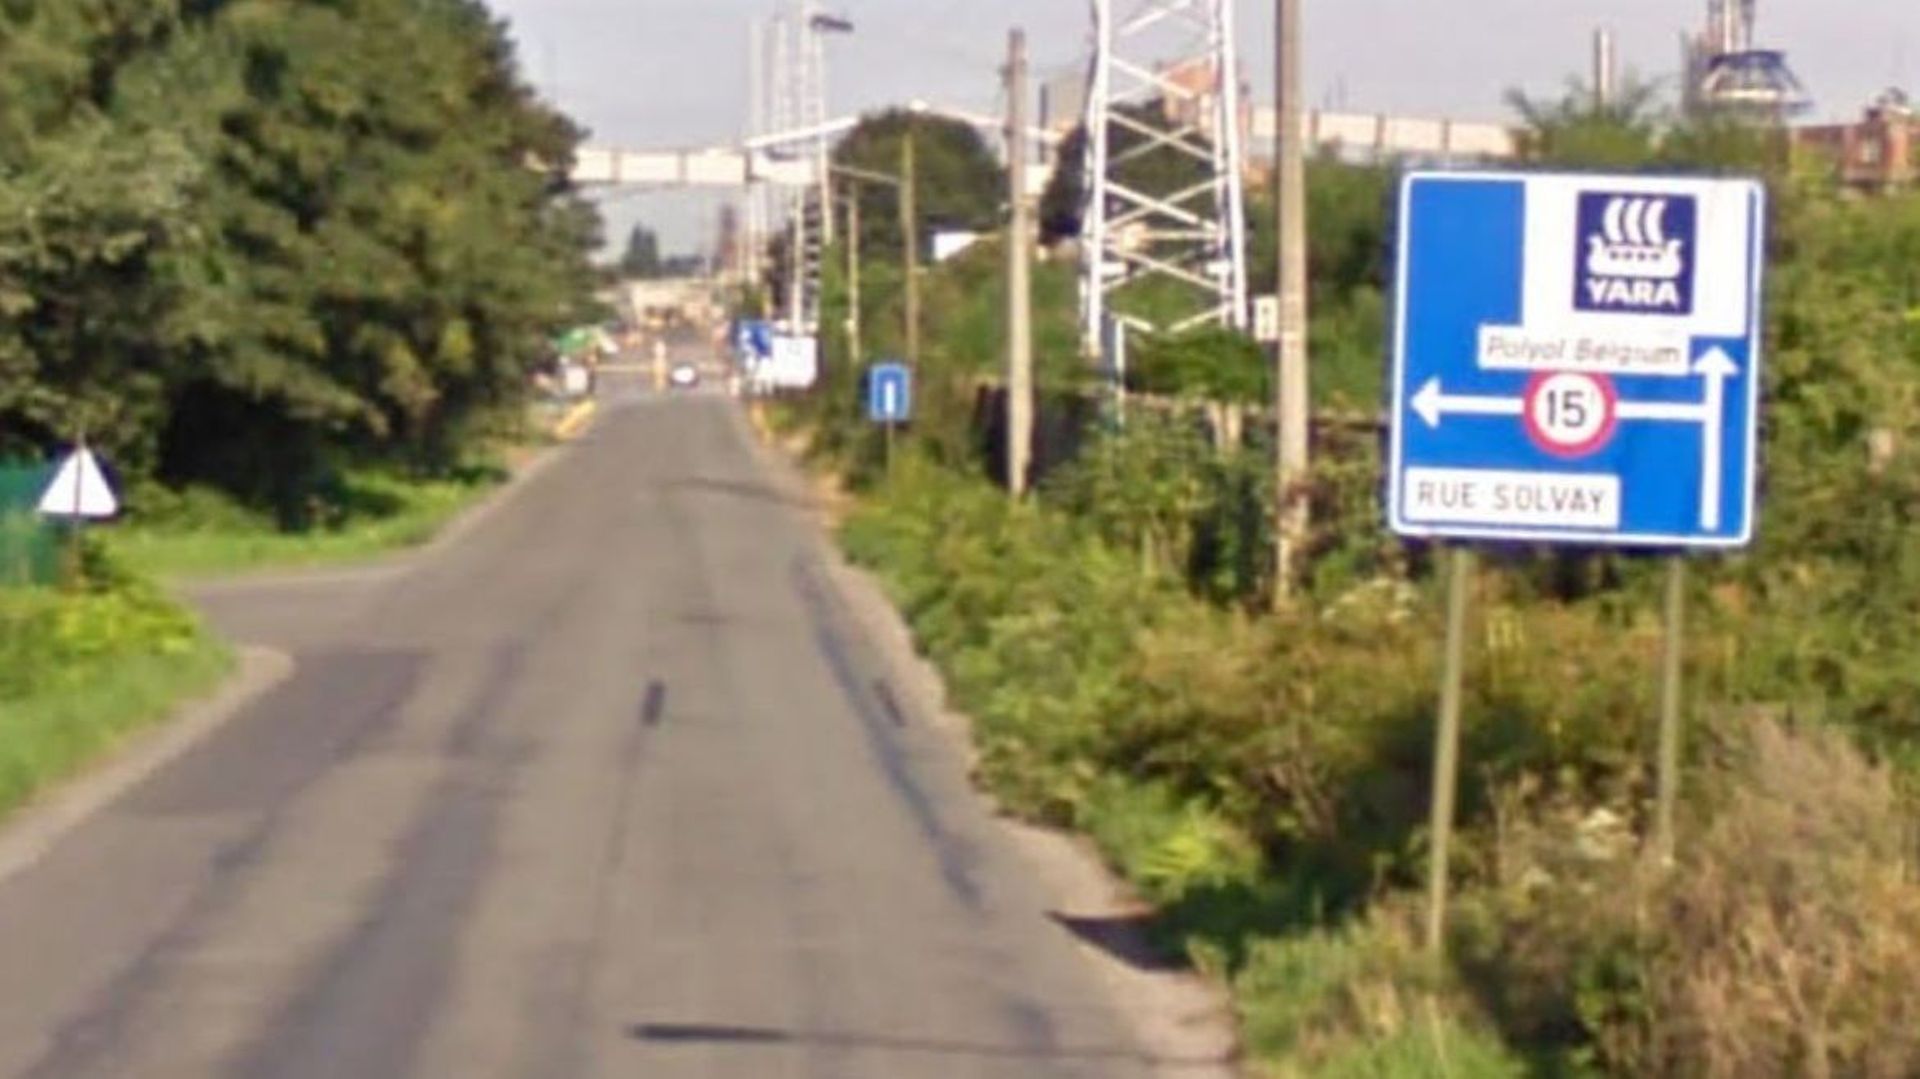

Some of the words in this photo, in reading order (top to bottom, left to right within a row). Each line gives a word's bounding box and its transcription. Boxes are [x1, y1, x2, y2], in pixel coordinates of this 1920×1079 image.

[1586, 279, 1680, 306] YARA
[1487, 335, 1565, 363] Polyol
[1573, 338, 1681, 366] Belgium
[1547, 390, 1587, 428] 15
[1417, 481, 1477, 508] RUE
[1494, 484, 1605, 513] SOLVAY
